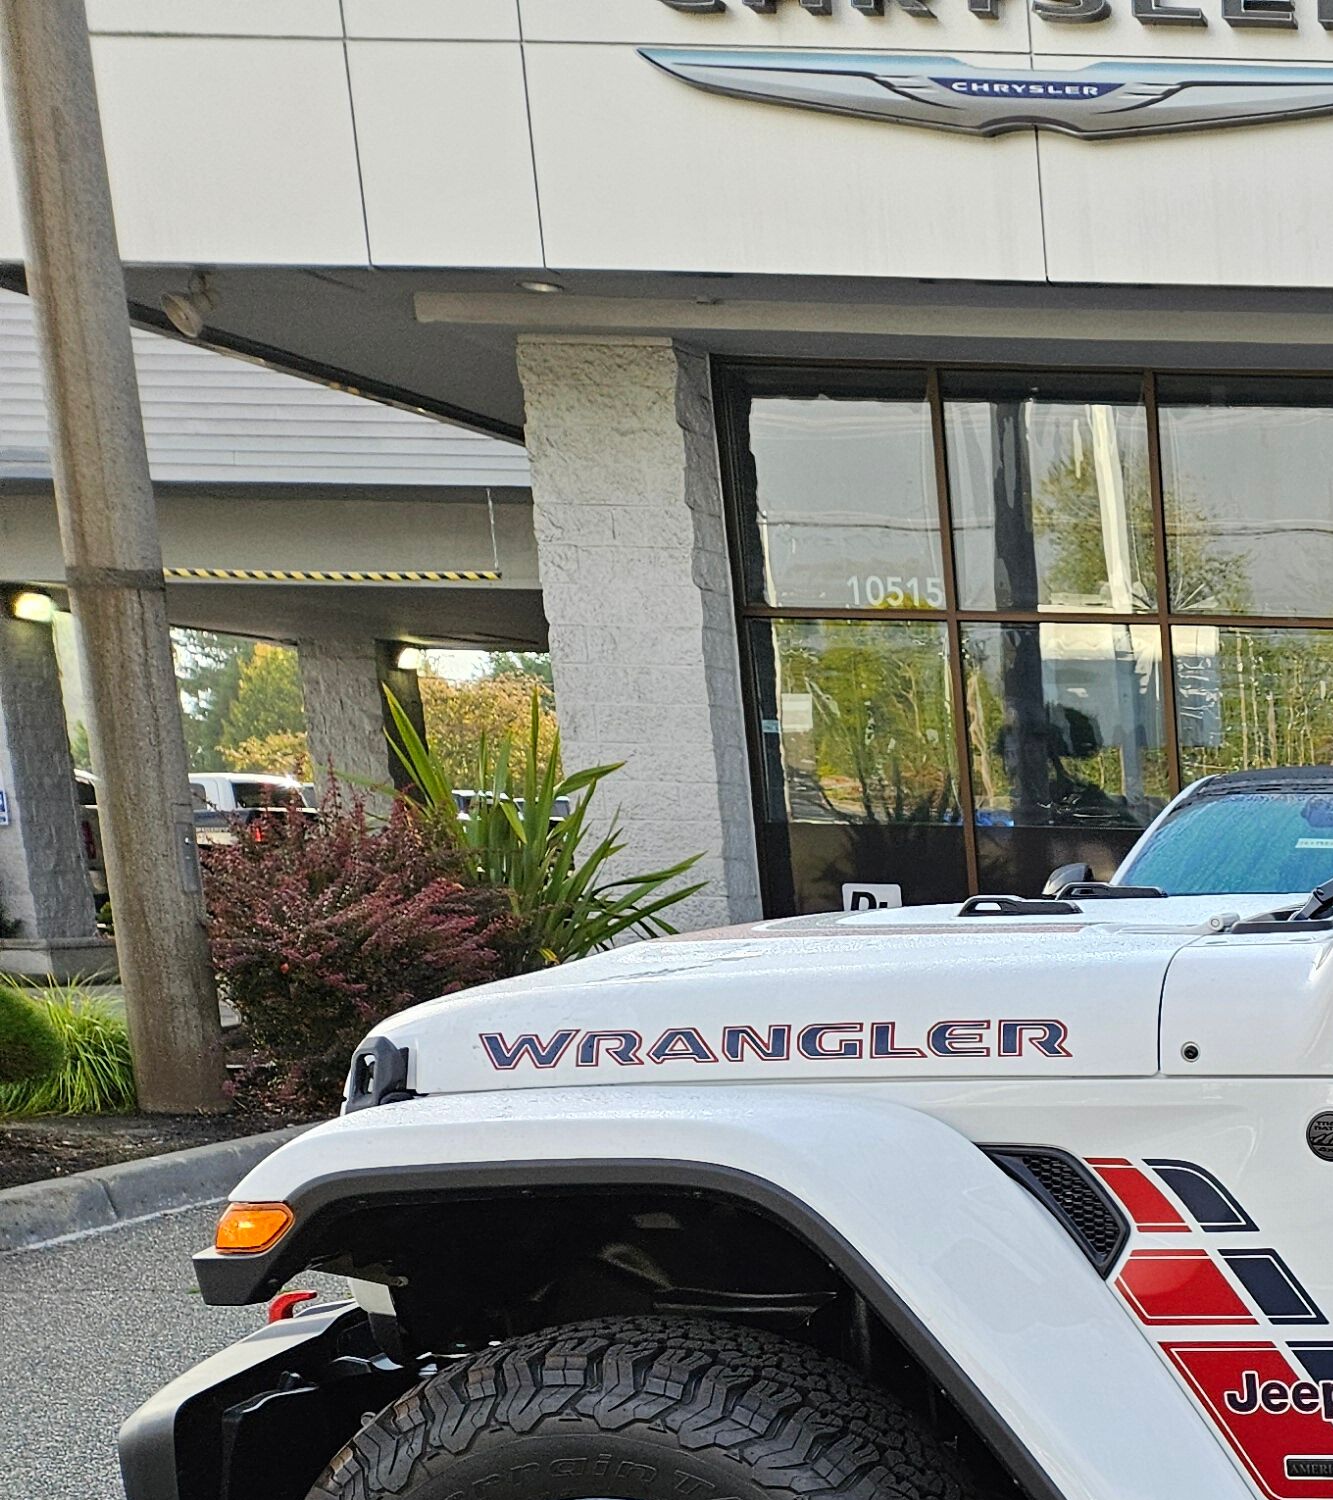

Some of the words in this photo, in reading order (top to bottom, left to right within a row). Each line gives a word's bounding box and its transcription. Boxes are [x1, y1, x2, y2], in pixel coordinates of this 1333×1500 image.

[951, 81, 1099, 96] CHRYSLER
[846, 575, 945, 608] 10515
[479, 1019, 1073, 1070] WRANGLER
